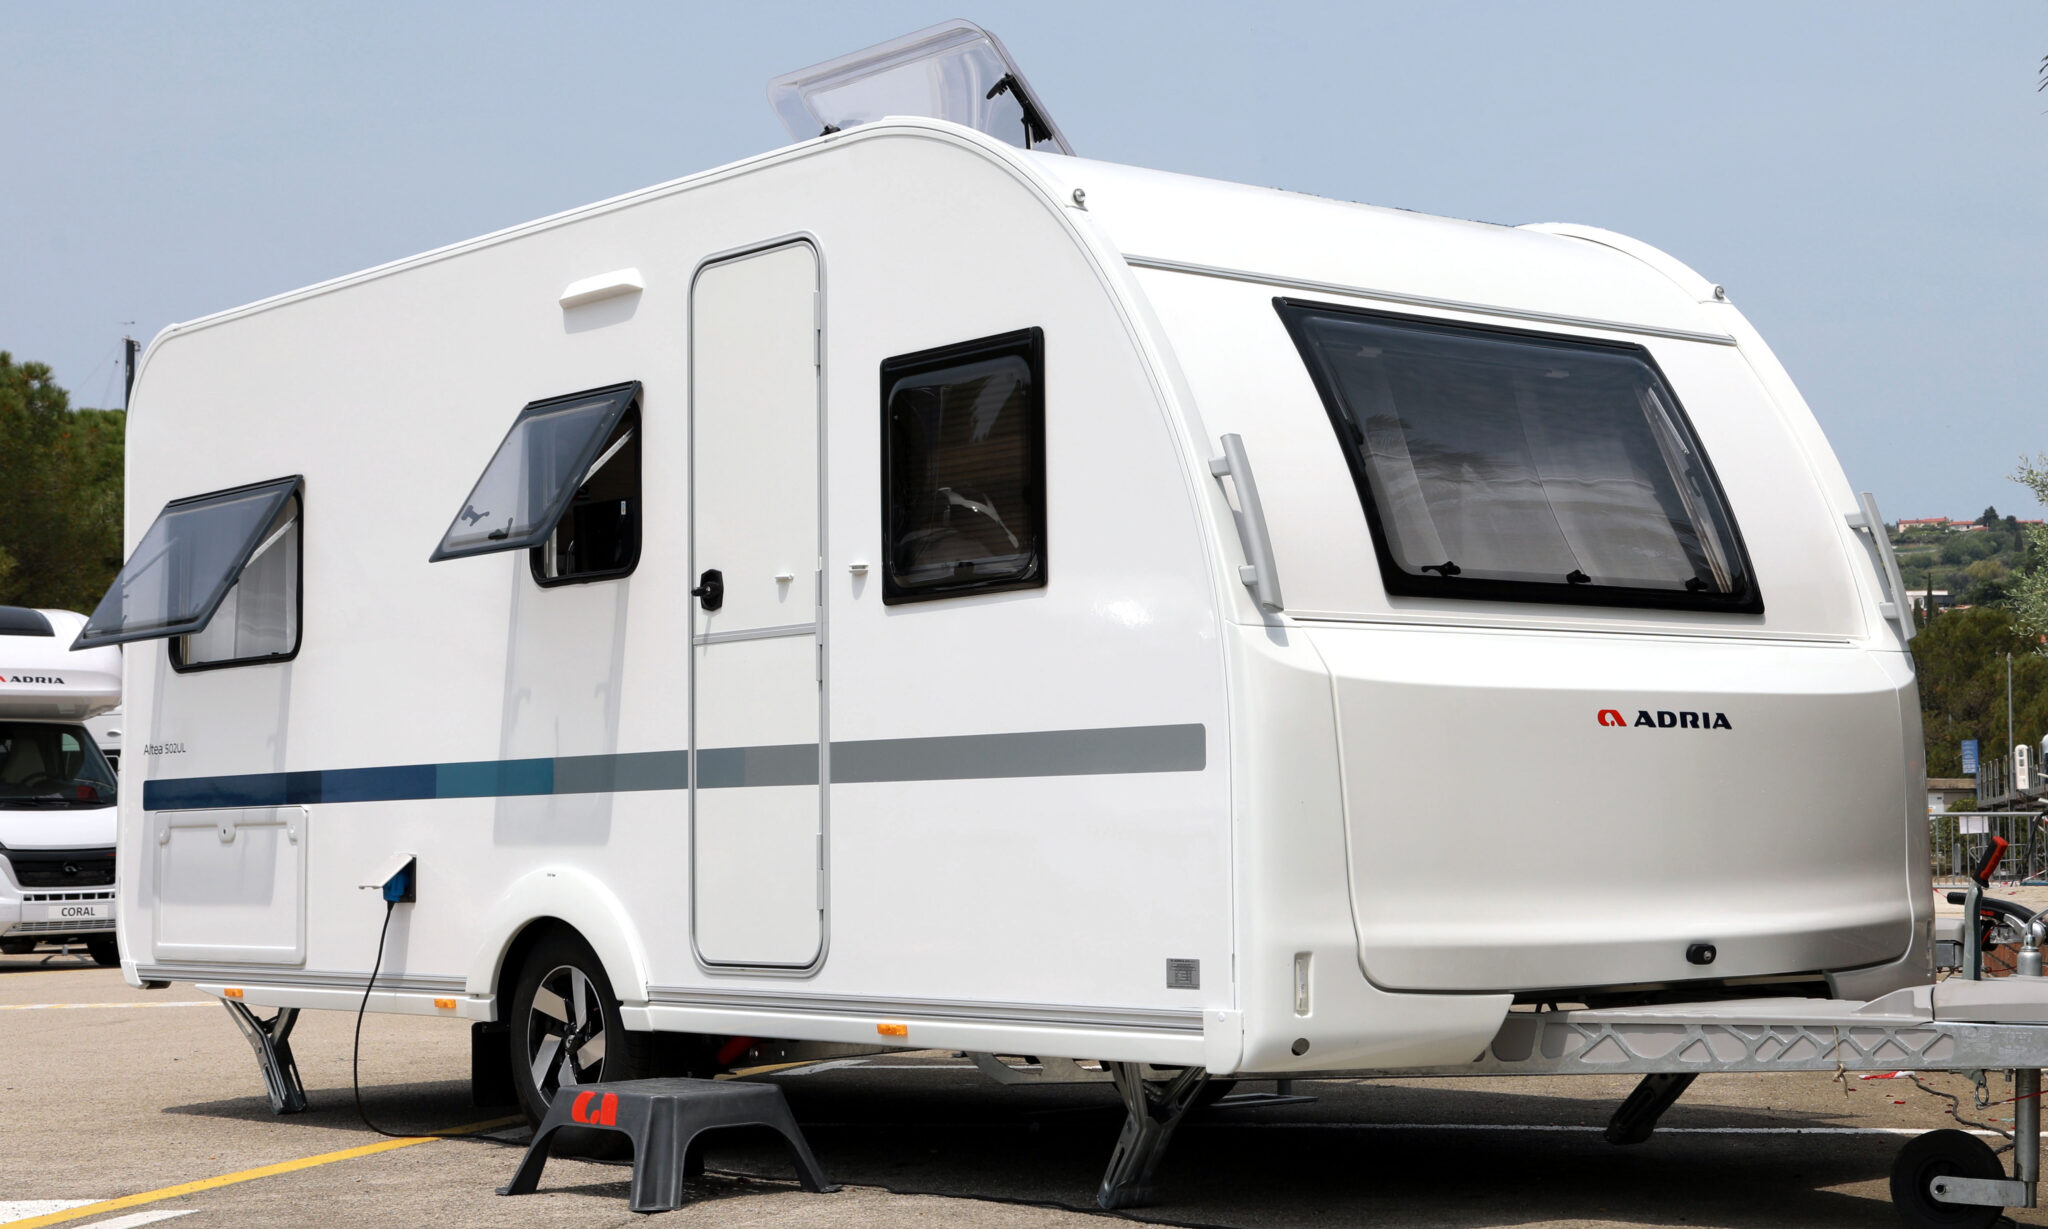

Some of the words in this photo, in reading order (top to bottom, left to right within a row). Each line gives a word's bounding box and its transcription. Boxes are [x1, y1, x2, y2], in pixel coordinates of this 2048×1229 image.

[10, 675, 65, 685] ADRIA
[1634, 710, 1732, 729] ADRIA
[143, 743, 163, 755] Altea
[165, 742, 186, 754] 502UL
[61, 907, 95, 916] CORAL
